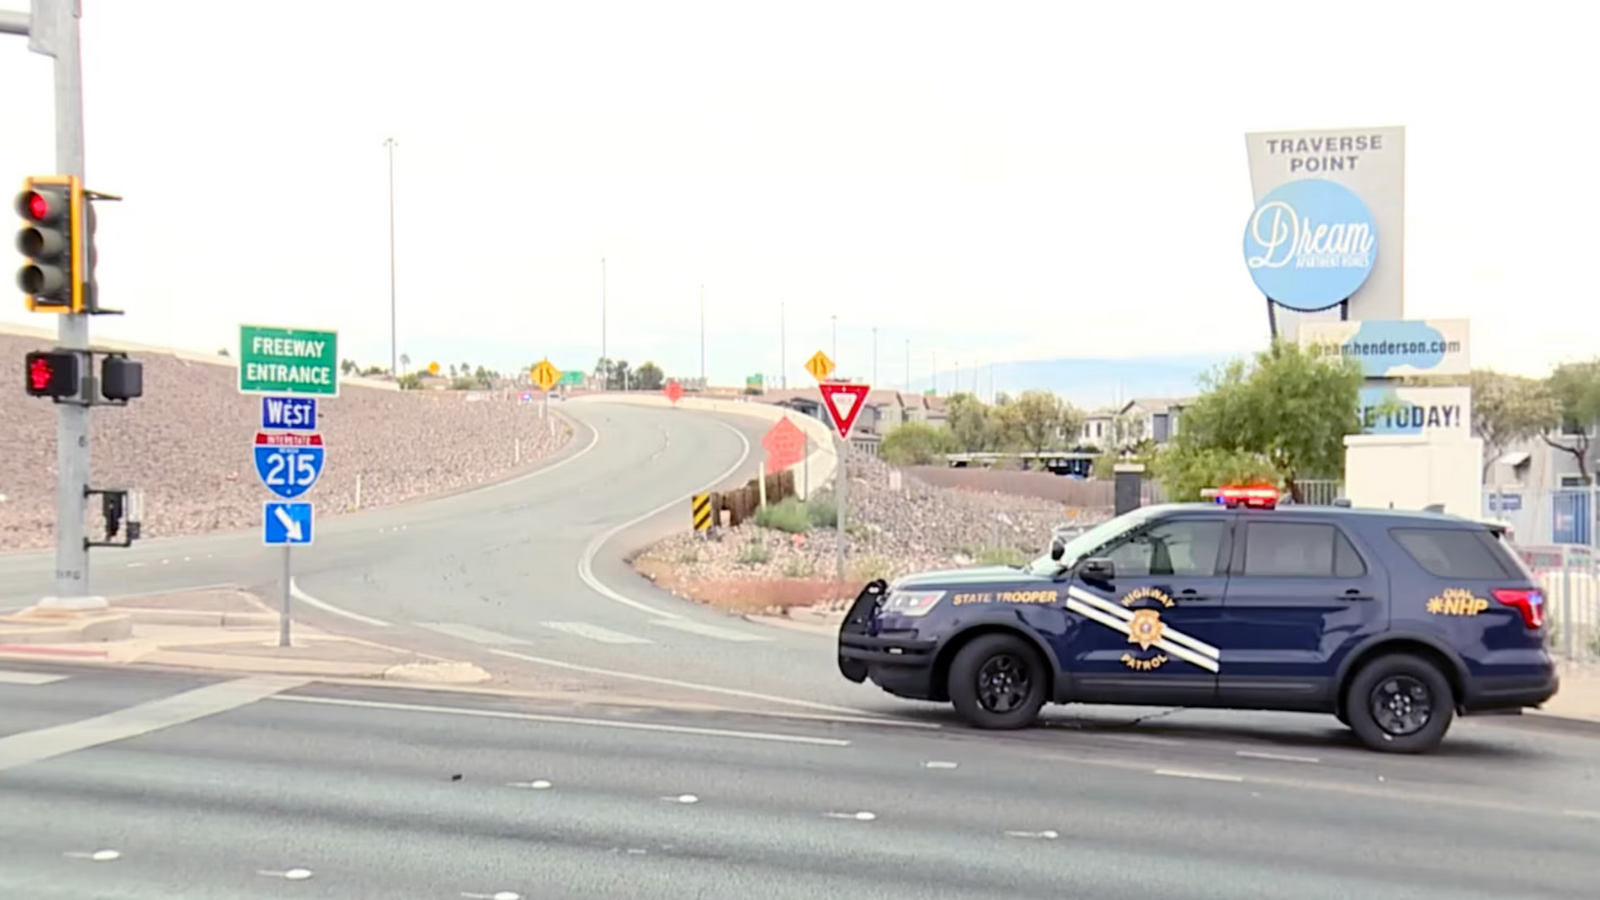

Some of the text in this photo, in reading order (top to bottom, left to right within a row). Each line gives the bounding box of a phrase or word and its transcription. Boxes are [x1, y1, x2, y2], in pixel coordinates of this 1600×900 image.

[1266, 135, 1383, 155] TRAVERSE
[1290, 155, 1360, 173] POINT
[1248, 201, 1375, 268] Dream
[253, 337, 325, 357] FREEWAY
[246, 363, 331, 384] ENTRANCE
[267, 398, 312, 425] WEST
[1384, 404, 1461, 428] TODAY!
[266, 453, 316, 486] 215
[953, 590, 1058, 606] STATE TROOPER
[1121, 587, 1175, 608] HIGHWAY
[1121, 653, 1168, 671] PATROL
